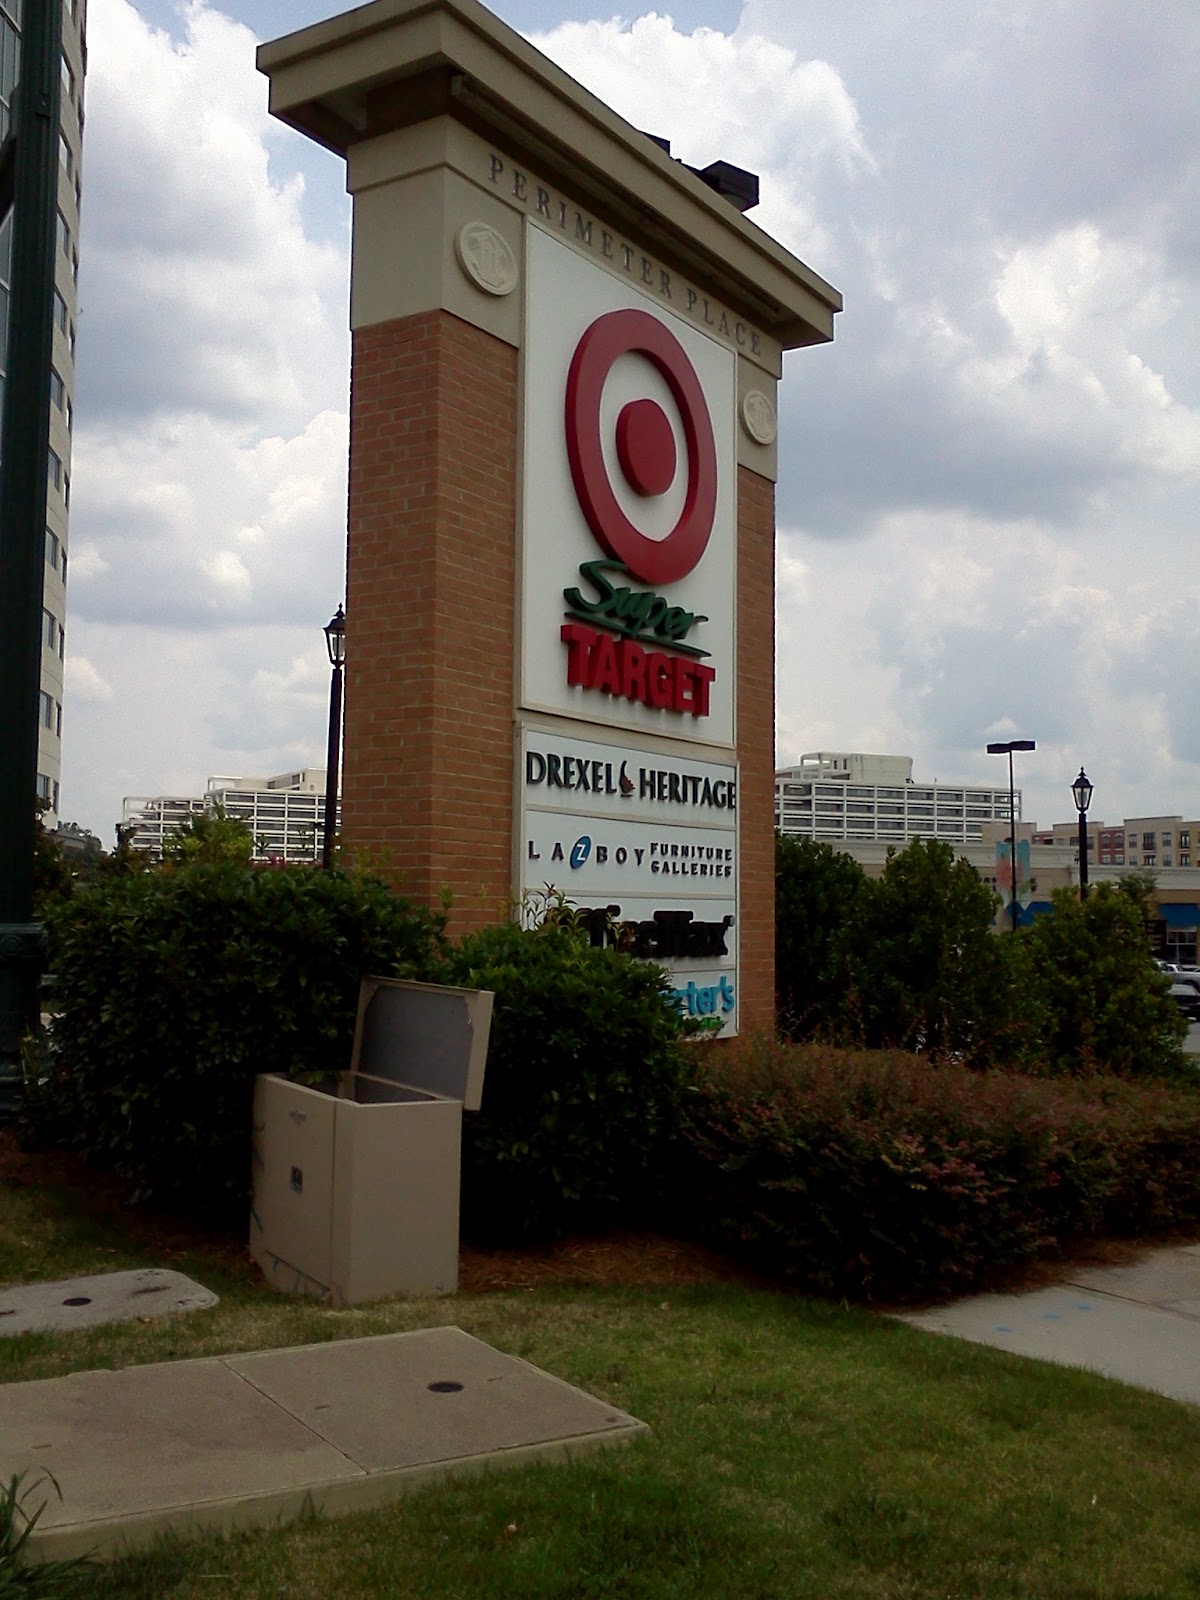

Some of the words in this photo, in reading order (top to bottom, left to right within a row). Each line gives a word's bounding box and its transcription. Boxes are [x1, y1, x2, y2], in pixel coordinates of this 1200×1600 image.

[489, 153, 672, 300] PERIMETER
[686, 287, 762, 356] PLACE
[563, 559, 709, 641] Super
[560, 624, 717, 719] TARGET
[526, 750, 617, 794] DREXEL
[639, 767, 736, 809] HERITAGE
[650, 842, 733, 861] FURNITURE
[650, 860, 732, 878] GALLERIES
